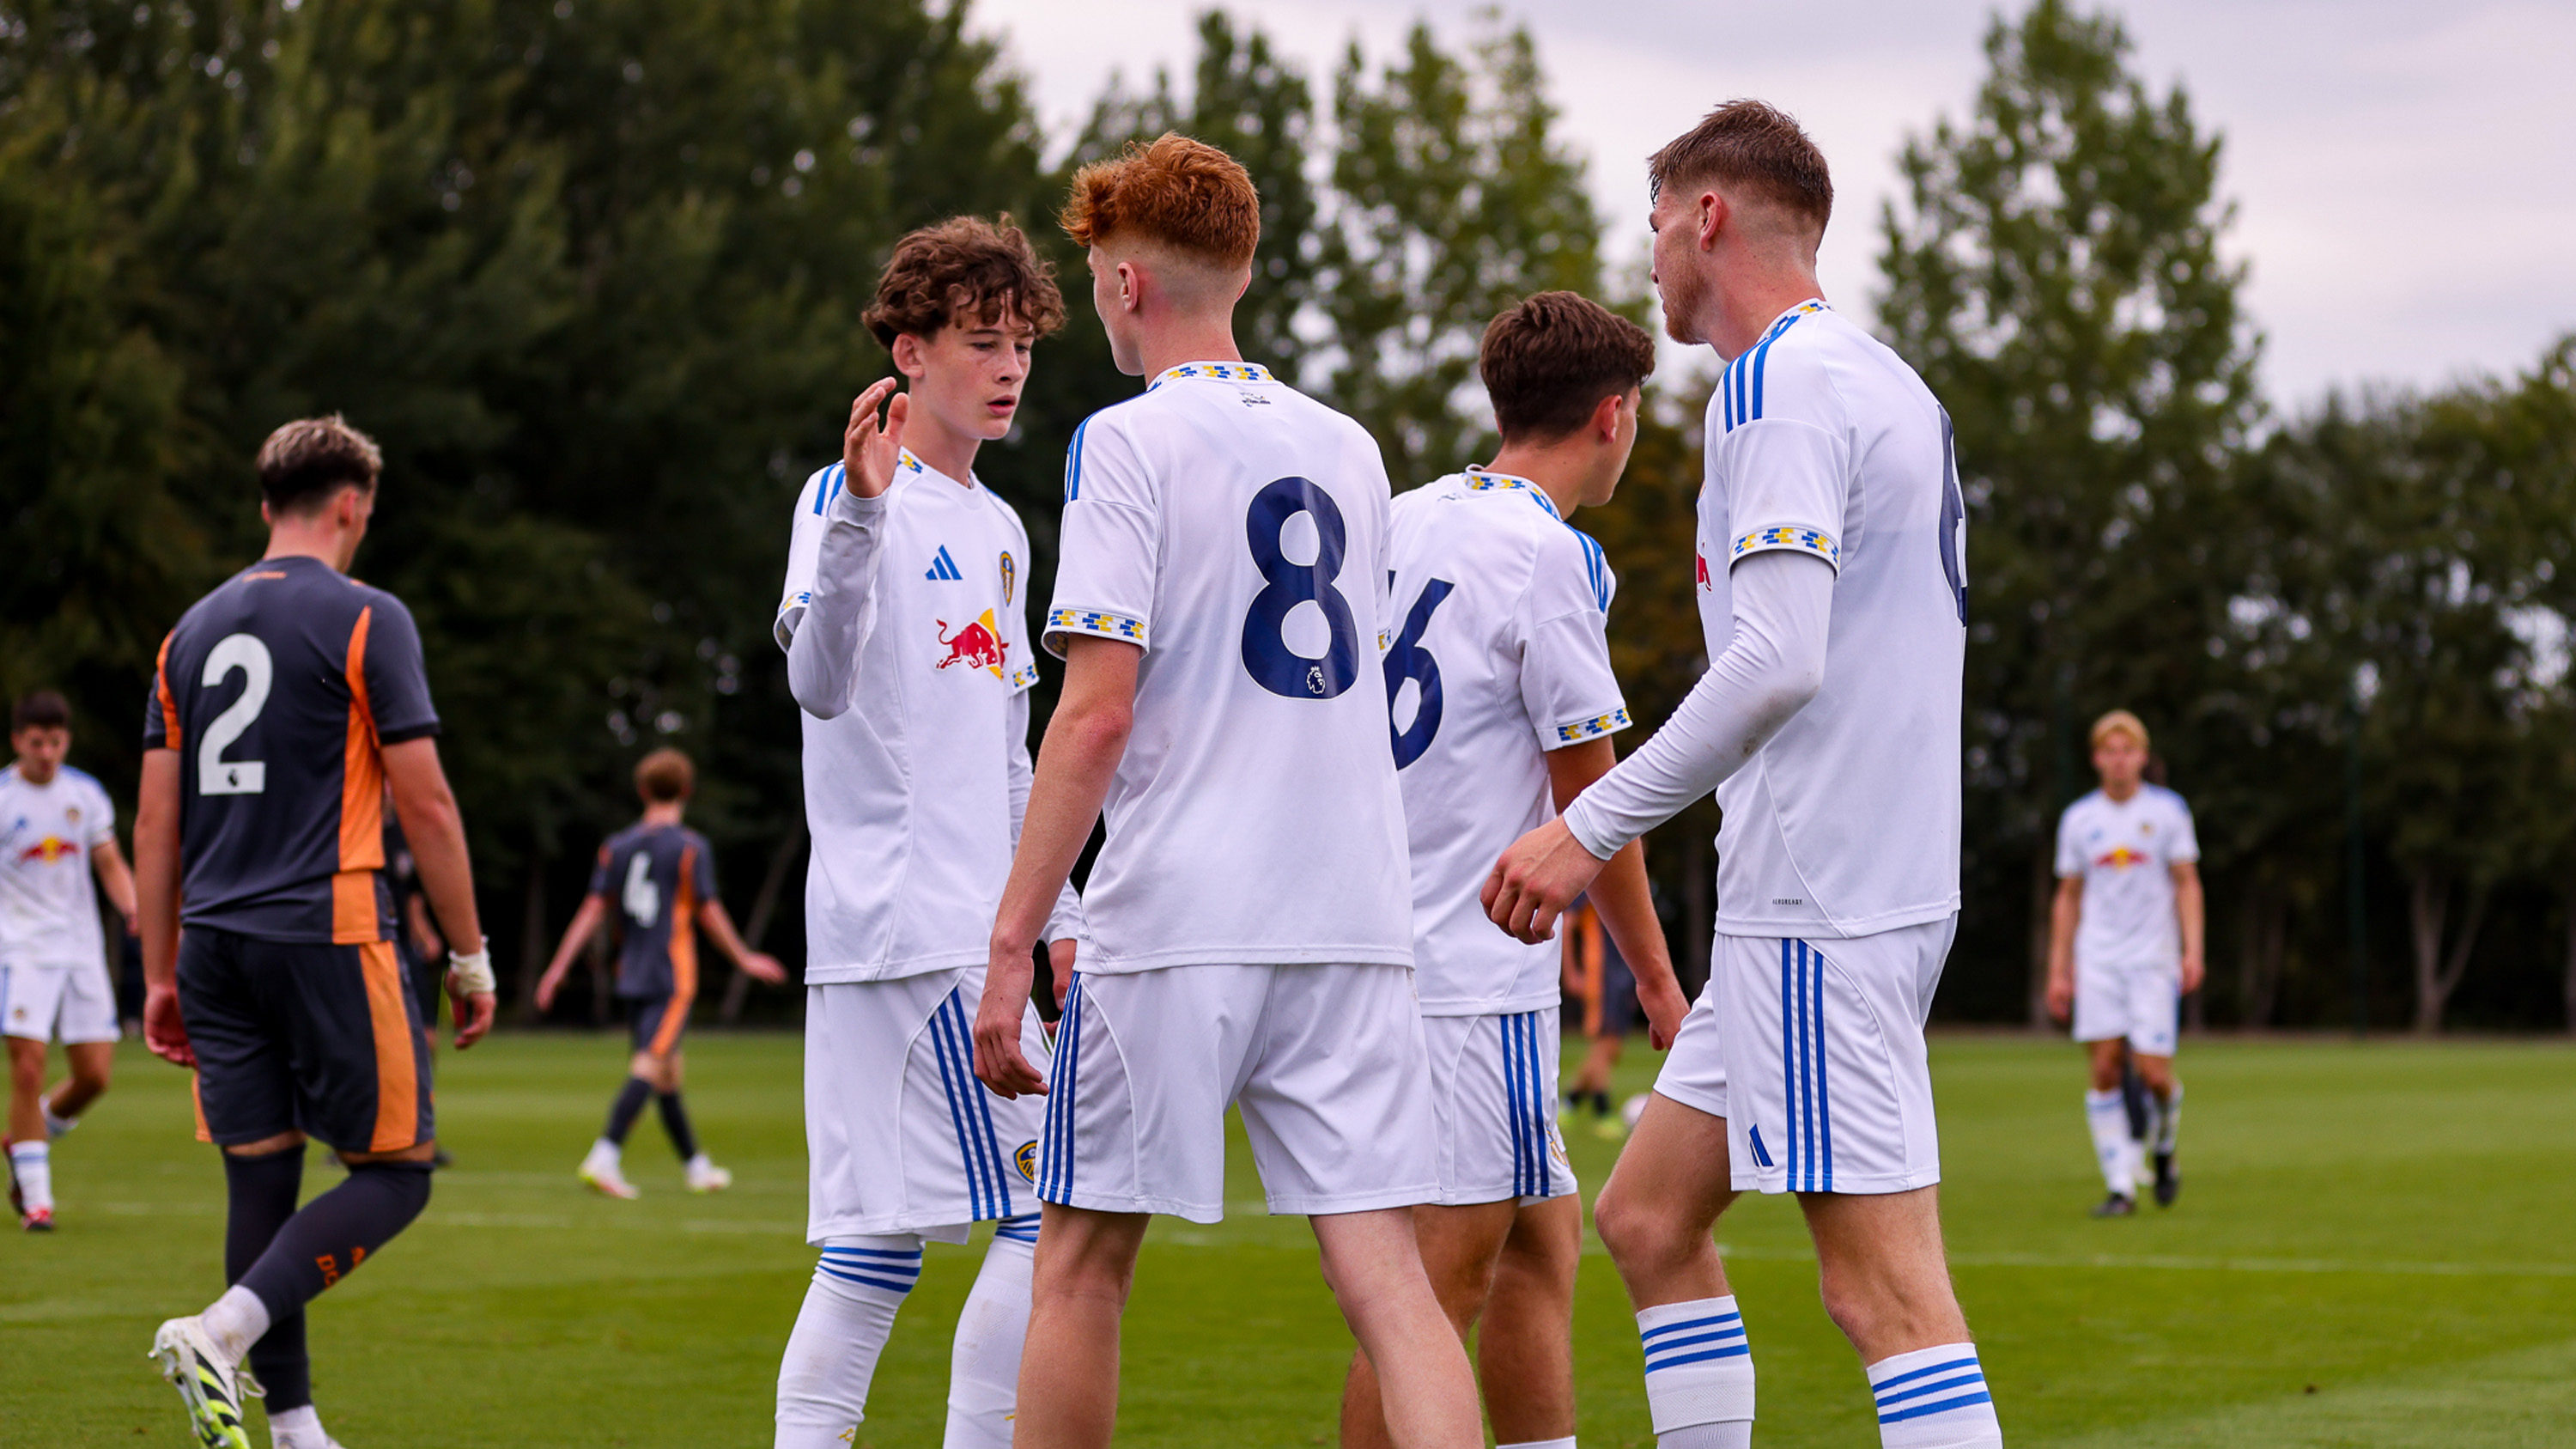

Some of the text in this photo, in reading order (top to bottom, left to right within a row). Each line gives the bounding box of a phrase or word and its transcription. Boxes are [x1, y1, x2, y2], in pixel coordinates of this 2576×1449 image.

[1241, 476, 1359, 700] 8
[1382, 569, 1455, 771] 6
[198, 633, 272, 795] 2
[623, 849, 660, 928] 4
